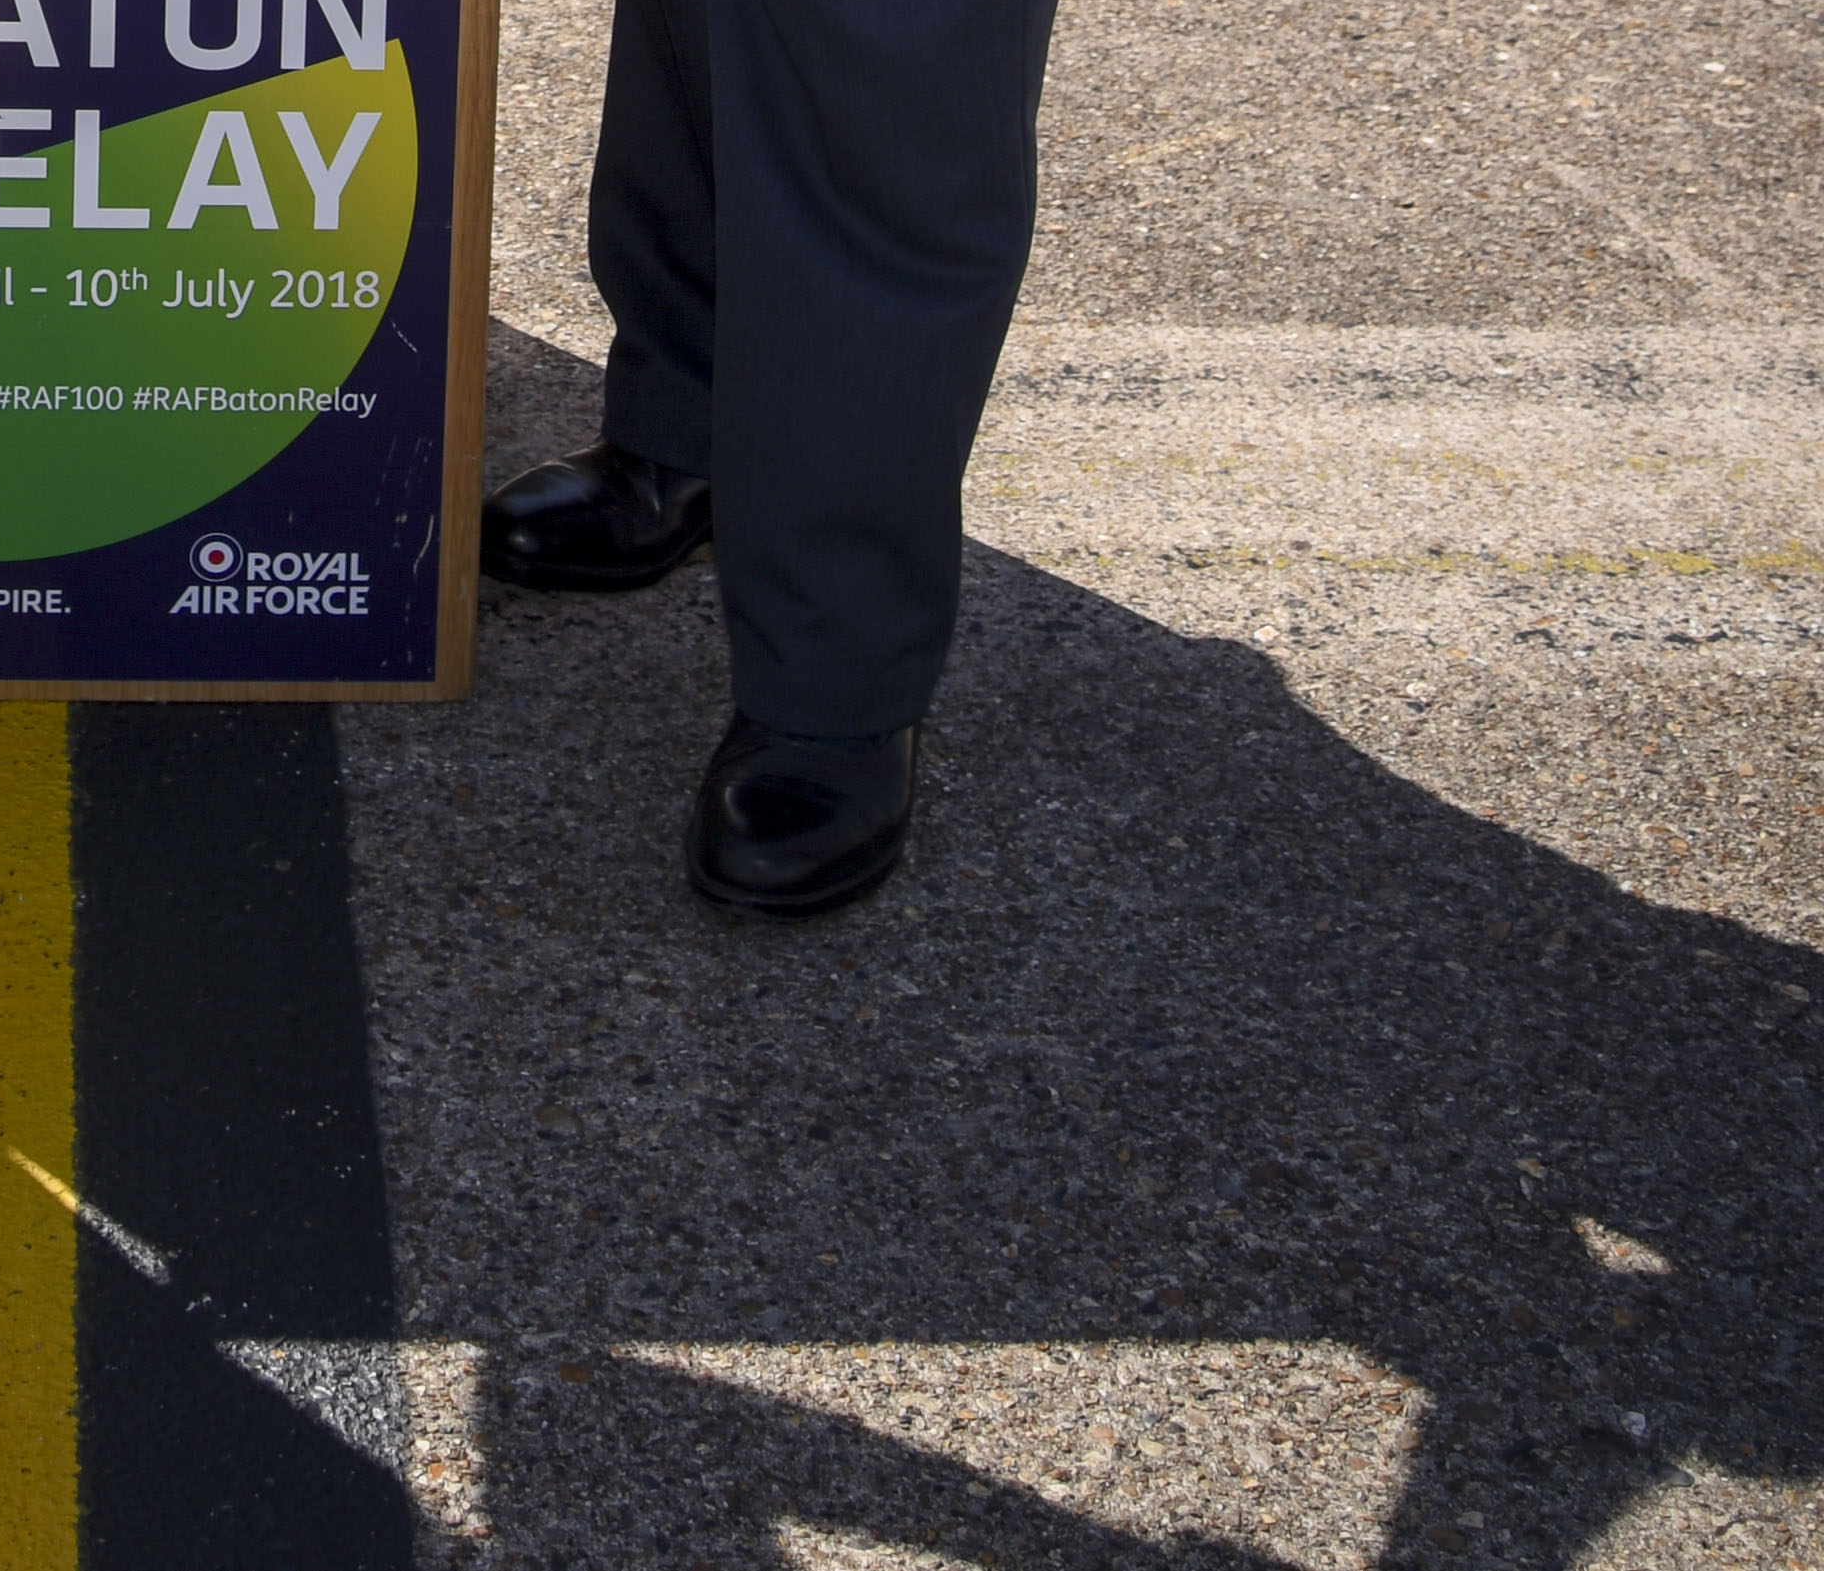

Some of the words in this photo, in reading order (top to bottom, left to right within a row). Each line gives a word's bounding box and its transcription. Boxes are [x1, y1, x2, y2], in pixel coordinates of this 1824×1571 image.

[66, 267, 149, 308] 10th
[162, 269, 255, 318] July
[270, 270, 381, 309] 2018
[132, 386, 377, 418] #RAFBatonRelay
[247, 552, 370, 582] ROYAL
[168, 585, 240, 615] AIR
[246, 585, 370, 615] FORCE
